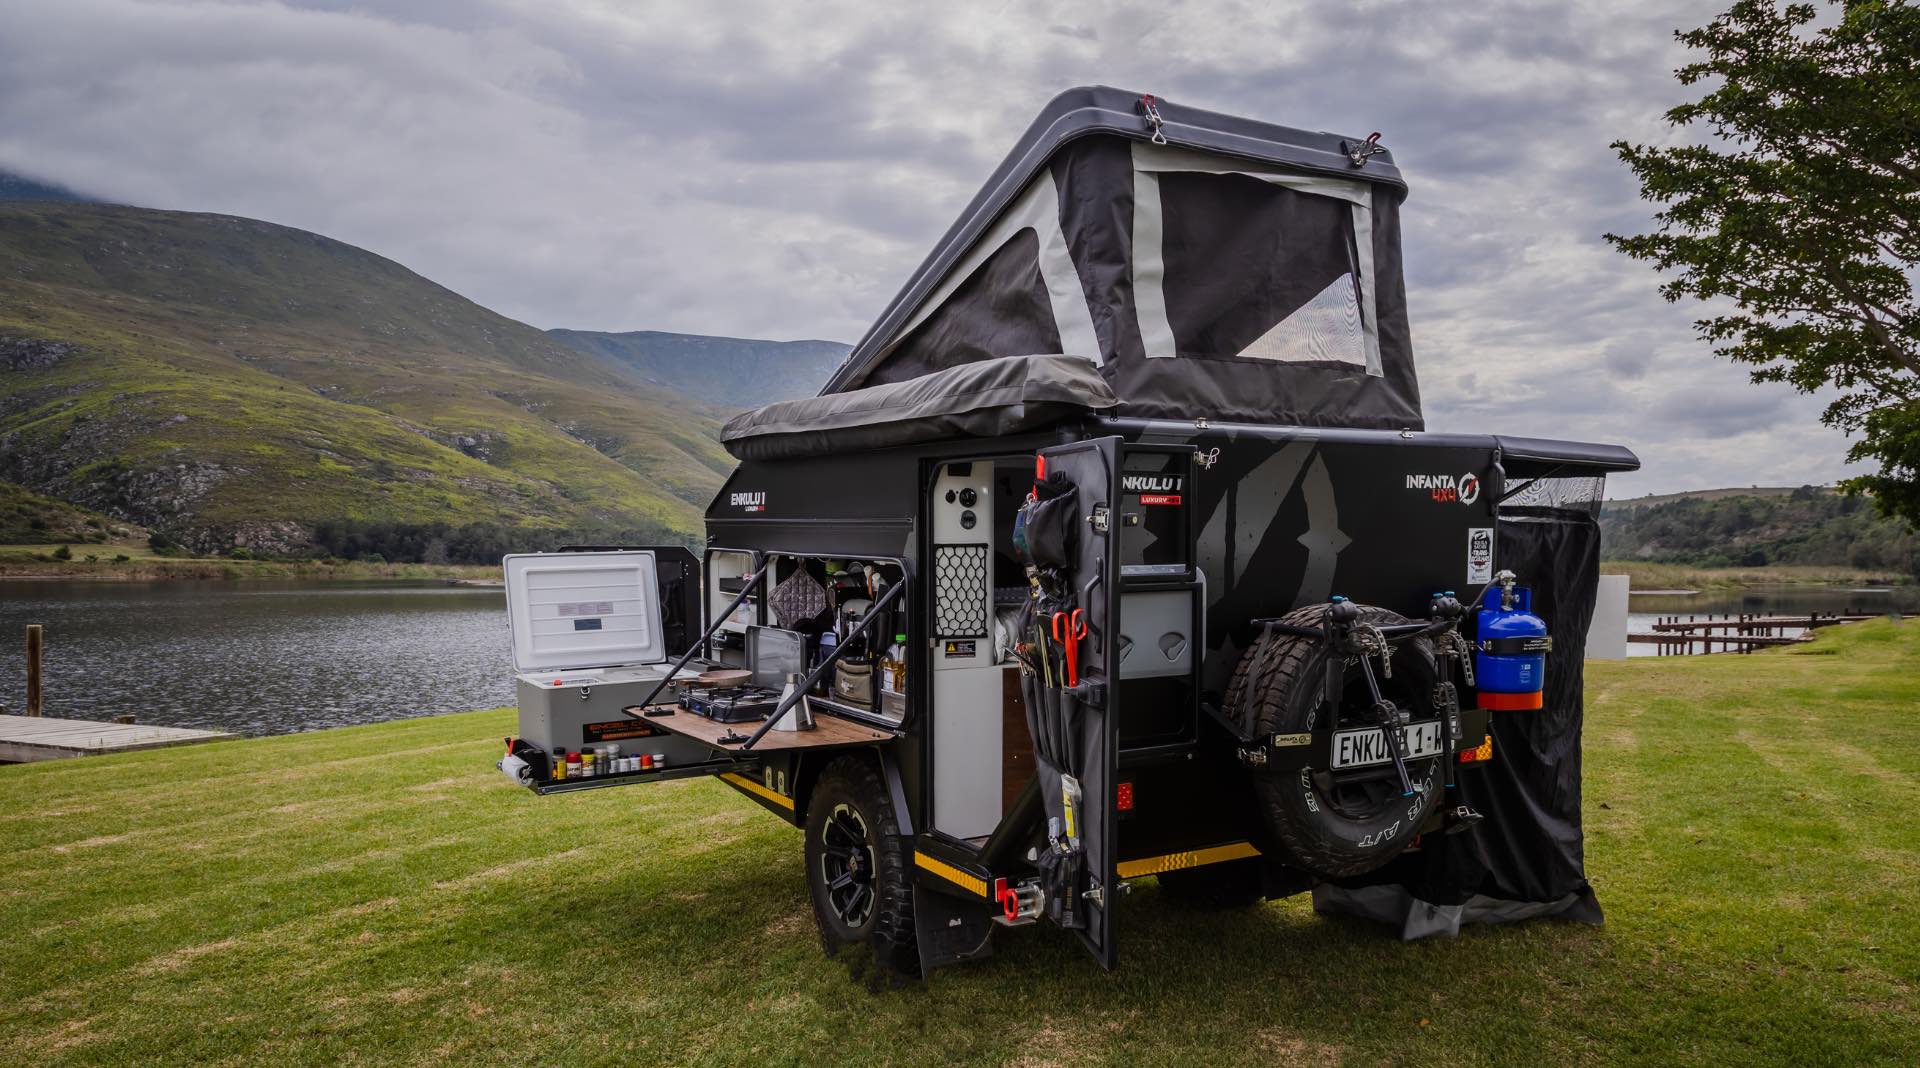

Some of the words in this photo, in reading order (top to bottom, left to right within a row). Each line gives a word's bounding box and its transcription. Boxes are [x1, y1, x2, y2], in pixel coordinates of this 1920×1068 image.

[1122, 476, 1173, 490] NKULU
[1406, 475, 1456, 489] INFANTA
[731, 492, 760, 505] ENKULU
